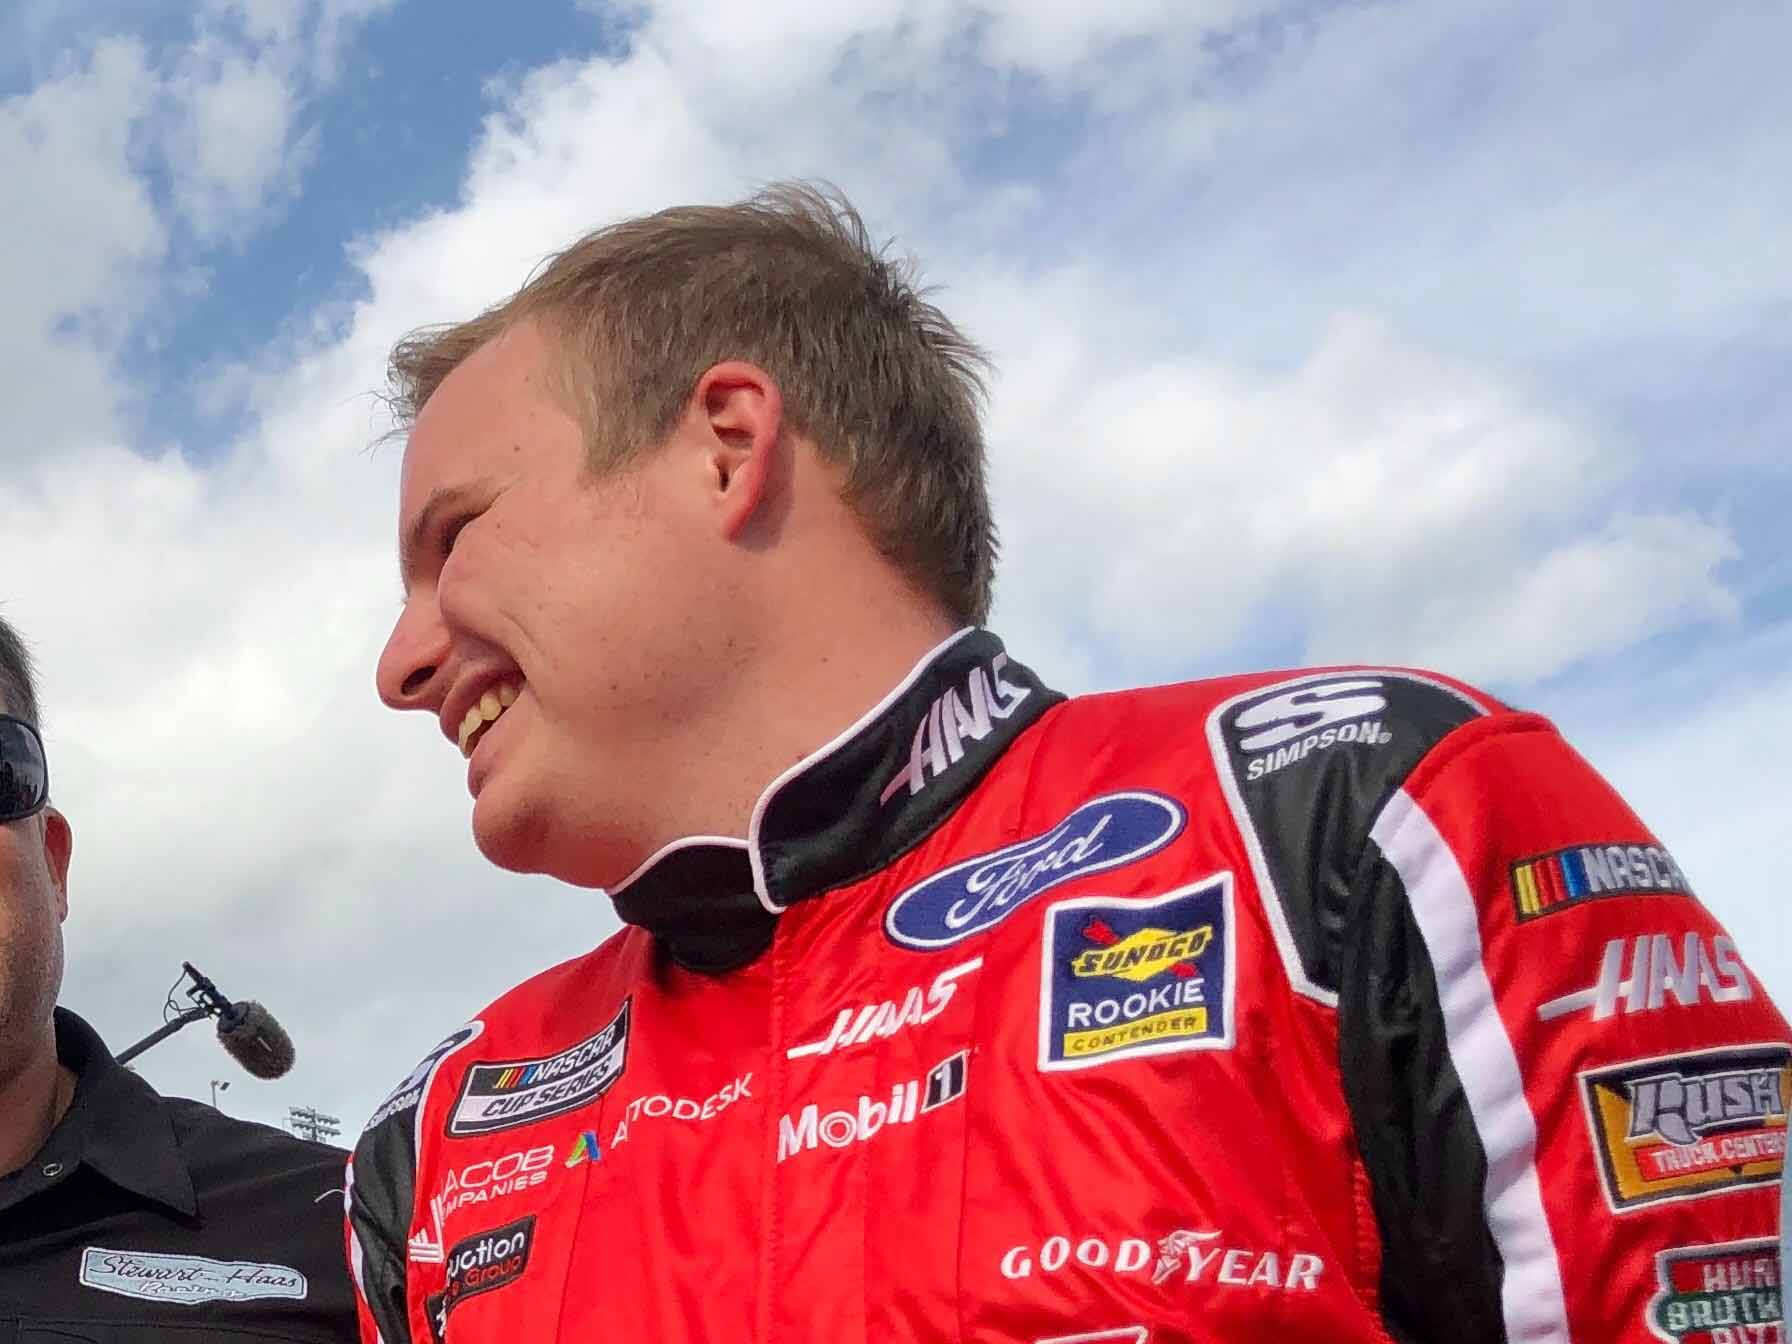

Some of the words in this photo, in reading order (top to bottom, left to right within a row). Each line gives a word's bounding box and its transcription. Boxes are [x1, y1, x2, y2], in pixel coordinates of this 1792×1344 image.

[1247, 722, 1380, 781] SIMPSON
[944, 813, 1113, 930] Ford
[1577, 845, 1693, 892] NASCA
[1080, 928, 1207, 975] SUNOCO
[1537, 932, 1753, 1022] HAAS
[787, 956, 984, 1060] HAAS
[1067, 978, 1205, 1029] ROOKIE
[1072, 1015, 1198, 1052] CONTENDER
[527, 1024, 616, 1085] NASCAR
[481, 1090, 534, 1117] CUP
[533, 1054, 614, 1106] SERIES
[610, 1072, 753, 1150] ATODESK
[1628, 1072, 1785, 1146] RUSH
[776, 1079, 919, 1164] Mobil
[1650, 1142, 1719, 1173] TRUCK
[464, 1255, 522, 1287] Group
